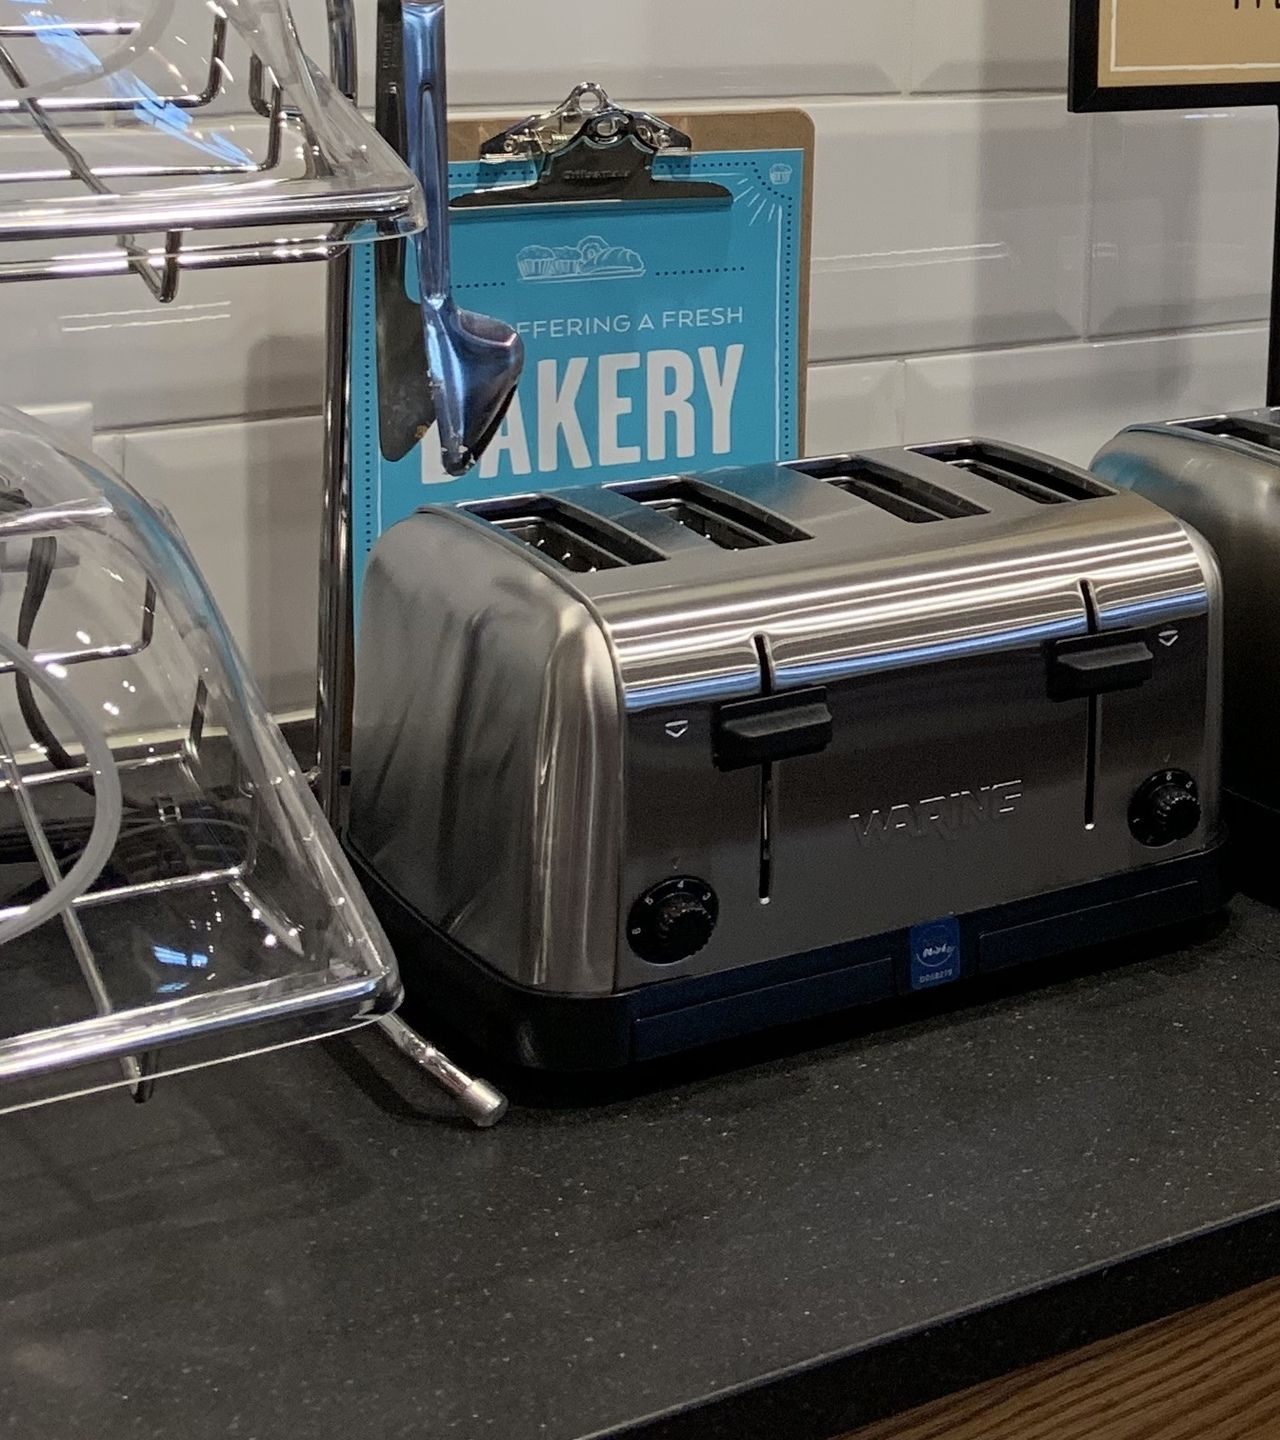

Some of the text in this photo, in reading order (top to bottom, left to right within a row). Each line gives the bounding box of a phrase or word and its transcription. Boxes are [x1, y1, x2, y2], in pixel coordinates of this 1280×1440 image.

[515, 306, 744, 339] FFERING A FRESH
